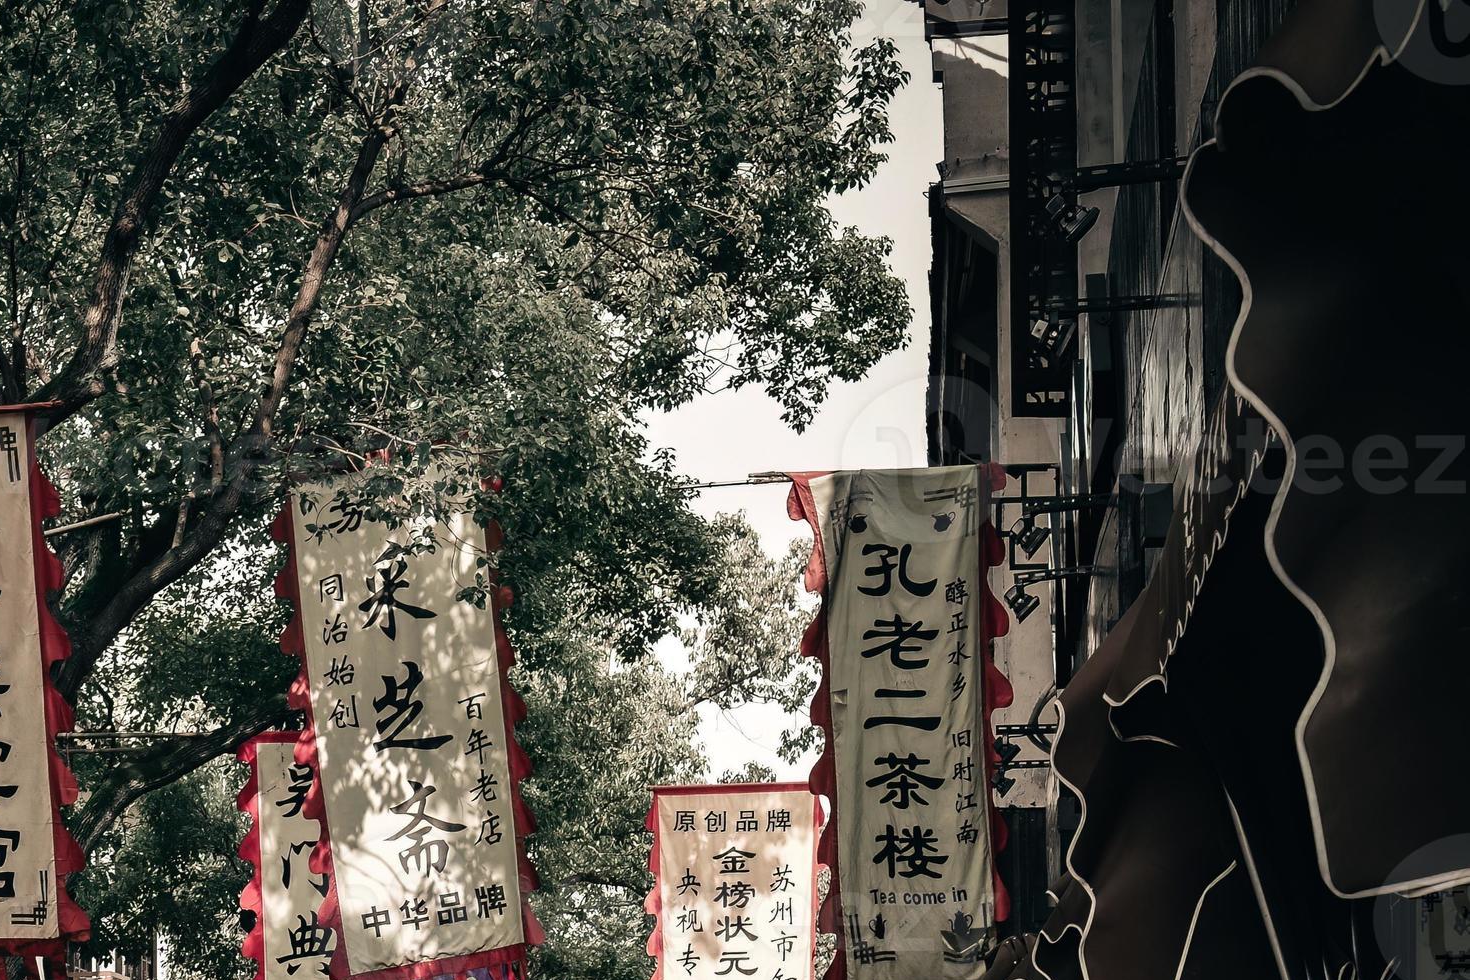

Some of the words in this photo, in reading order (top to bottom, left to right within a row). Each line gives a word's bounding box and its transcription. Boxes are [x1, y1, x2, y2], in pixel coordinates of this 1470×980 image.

[319, 573, 360, 729] 同治始创
[944, 580, 969, 702] 醇正水乡
[457, 692, 503, 846] 百年老店
[857, 543, 949, 879] 孔老二茶楼
[673, 809, 792, 833] 原创品牌
[951, 728, 979, 847] 旧时江南
[361, 884, 507, 938] 中华品牌
[871, 888, 897, 905] Tea
[903, 889, 946, 905] come
[952, 887, 968, 903] in
